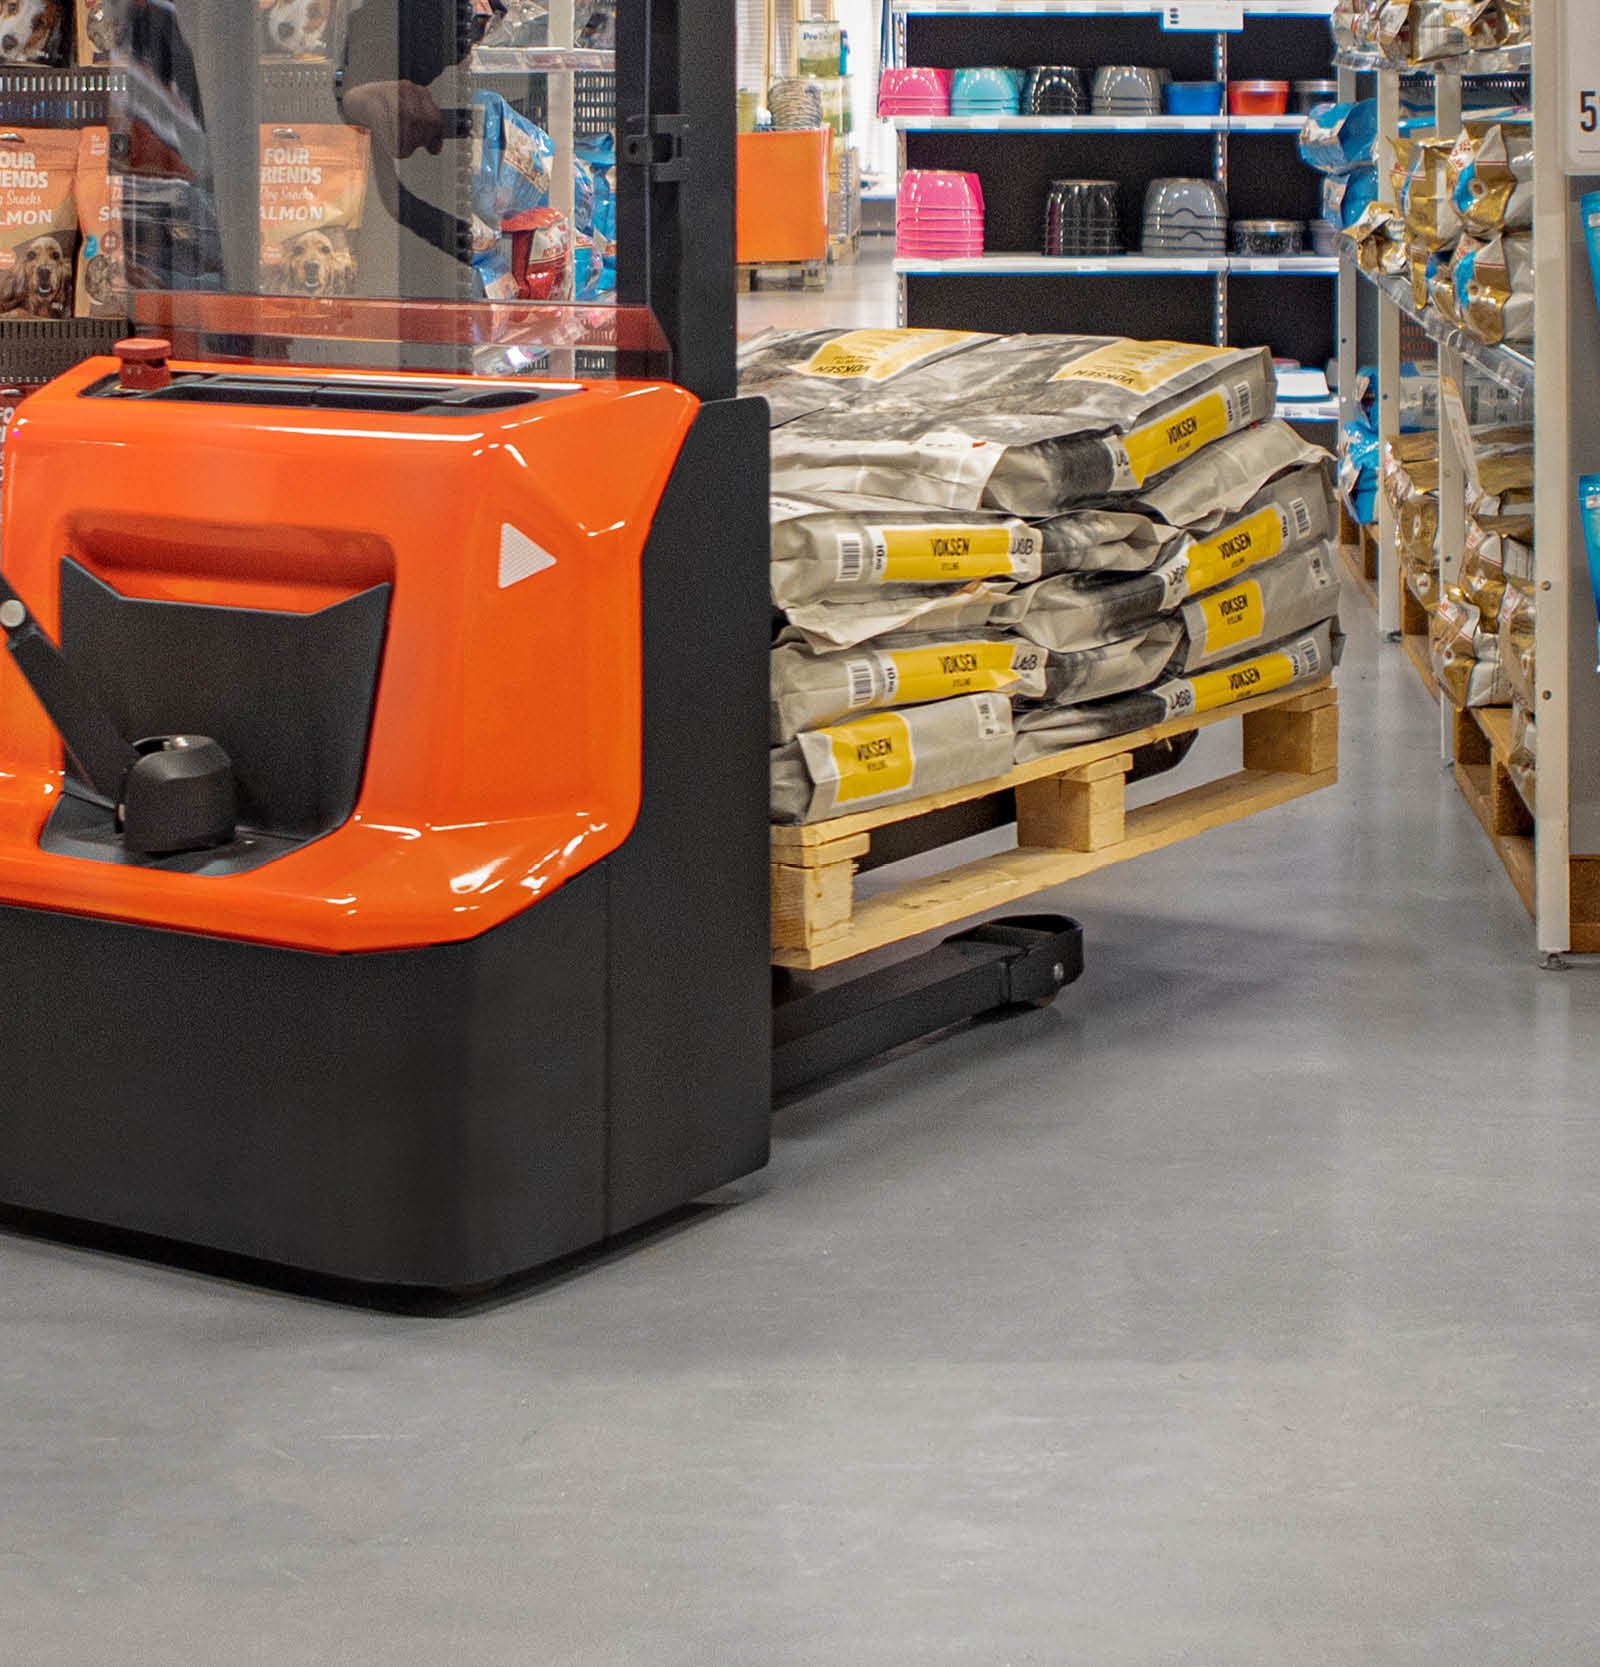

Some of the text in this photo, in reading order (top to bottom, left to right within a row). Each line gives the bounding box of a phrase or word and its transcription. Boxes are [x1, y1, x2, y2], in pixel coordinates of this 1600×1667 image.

[1580, 90, 1597, 132] 5
[264, 148, 309, 165] FOUR
[260, 166, 322, 185] RIENDS
[260, 205, 323, 221] ALMON
[1218, 594, 1249, 617] VOKSEN
